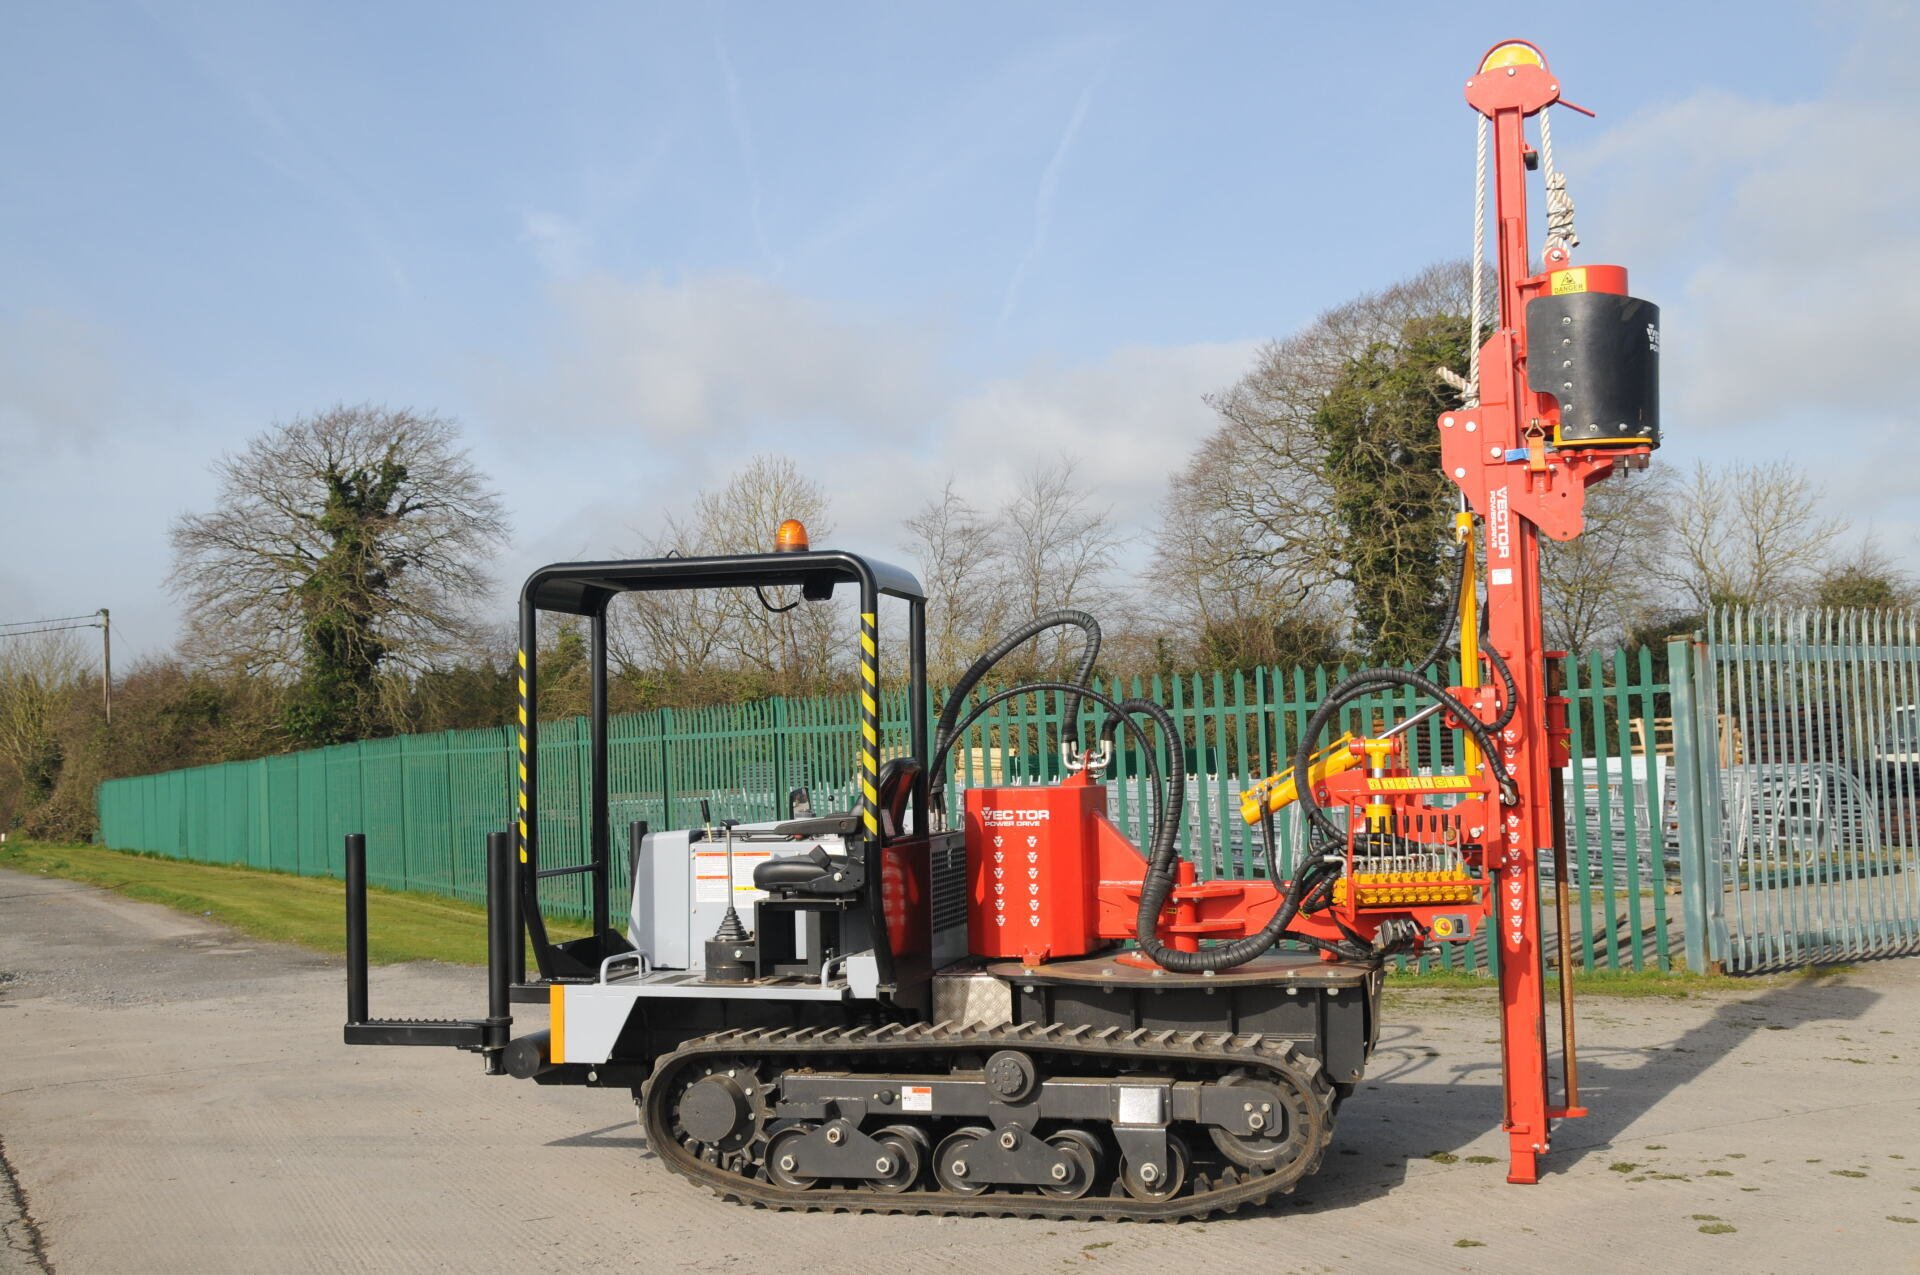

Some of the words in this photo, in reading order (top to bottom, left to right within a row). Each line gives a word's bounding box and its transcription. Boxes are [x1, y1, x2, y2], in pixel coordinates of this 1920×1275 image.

[1554, 283, 1583, 294] DANGER
[1497, 486, 1510, 558] VECTOR
[981, 807, 1050, 820] VECTOR
